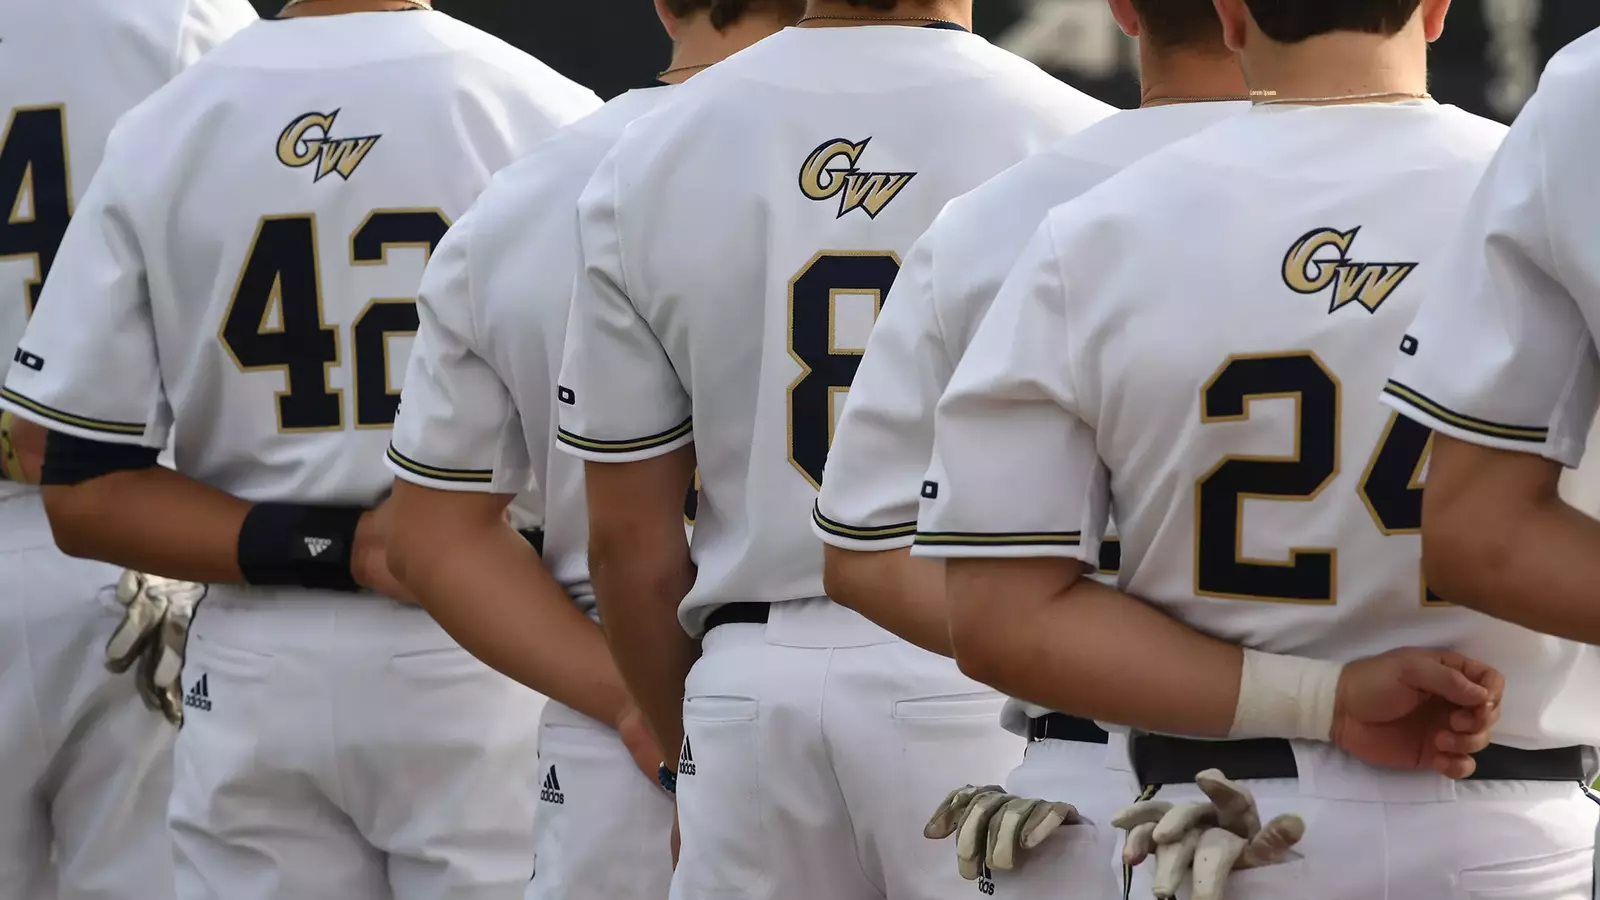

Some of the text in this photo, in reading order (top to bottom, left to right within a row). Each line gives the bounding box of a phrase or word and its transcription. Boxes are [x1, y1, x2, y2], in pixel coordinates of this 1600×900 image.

[217, 207, 452, 434] 42
[1194, 349, 1456, 607] 2
[540, 787, 565, 805] adidas
